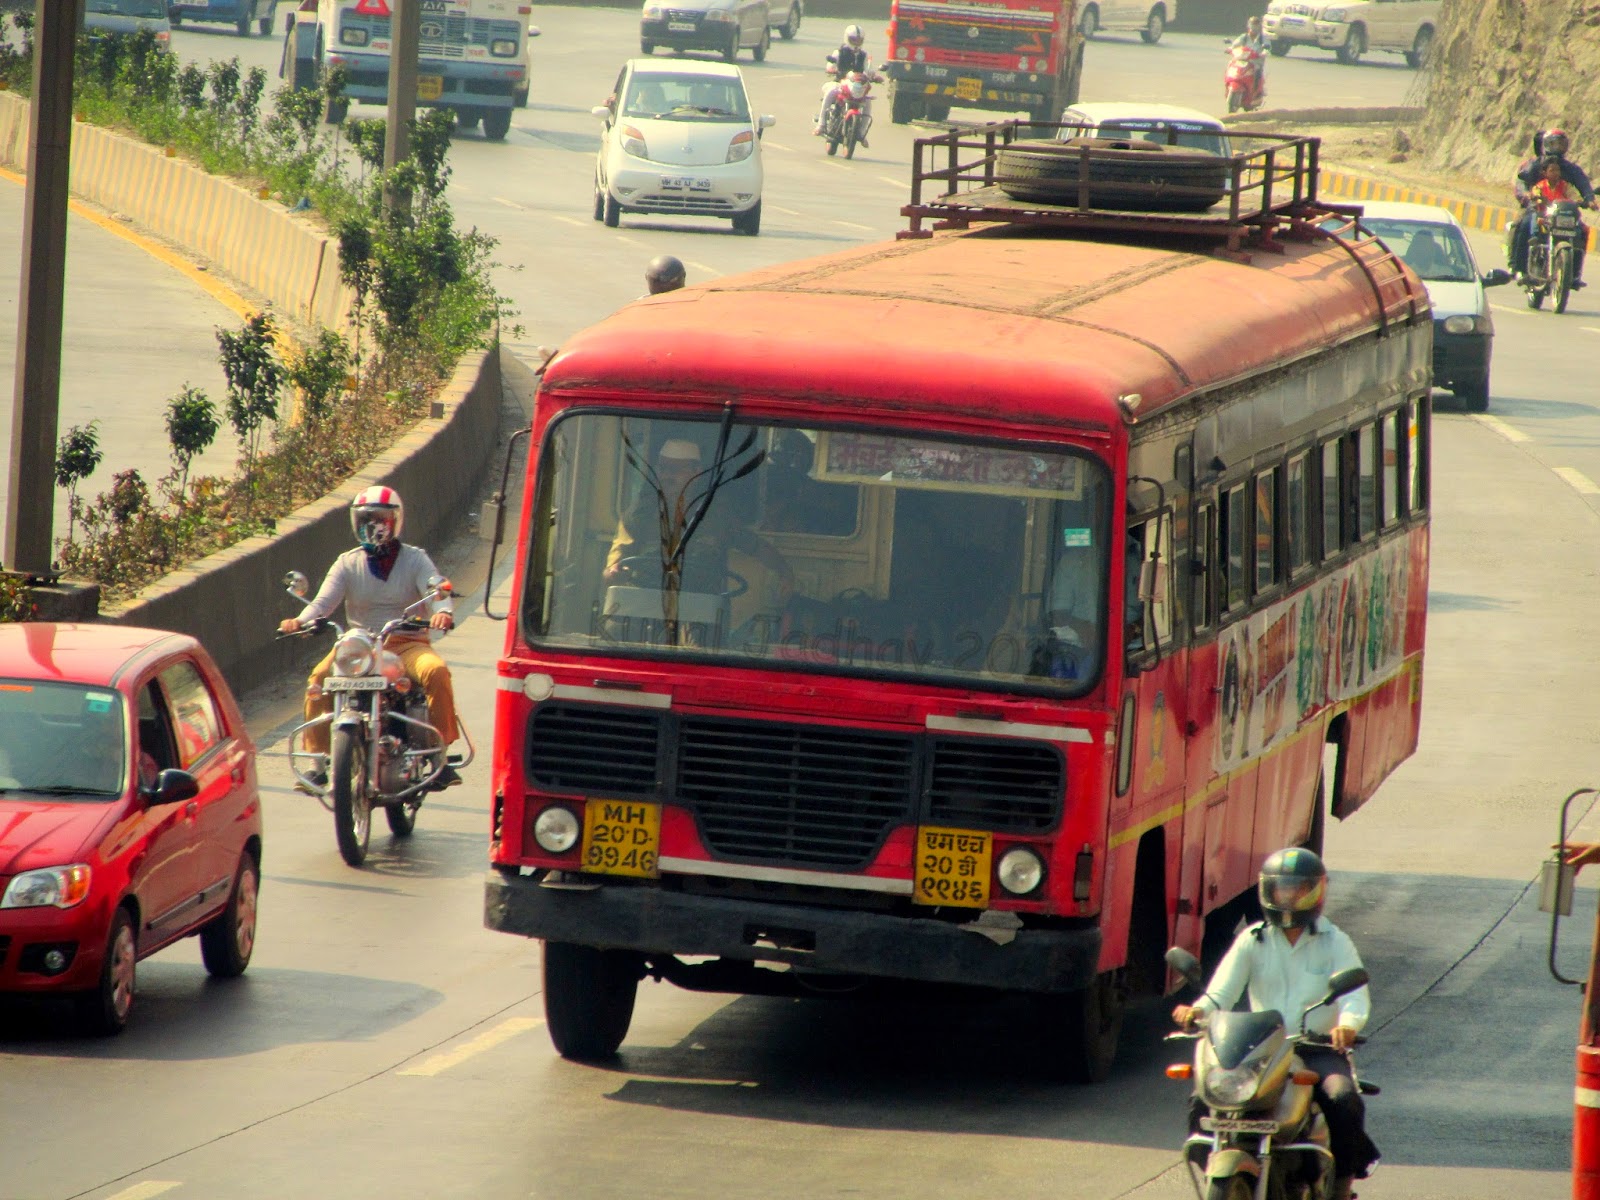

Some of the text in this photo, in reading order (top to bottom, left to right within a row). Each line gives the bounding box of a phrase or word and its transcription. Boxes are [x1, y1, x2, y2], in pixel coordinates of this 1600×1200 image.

[329, 681, 342, 689] MH
[605, 804, 646, 825] MH
[588, 845, 656, 872] 9946
